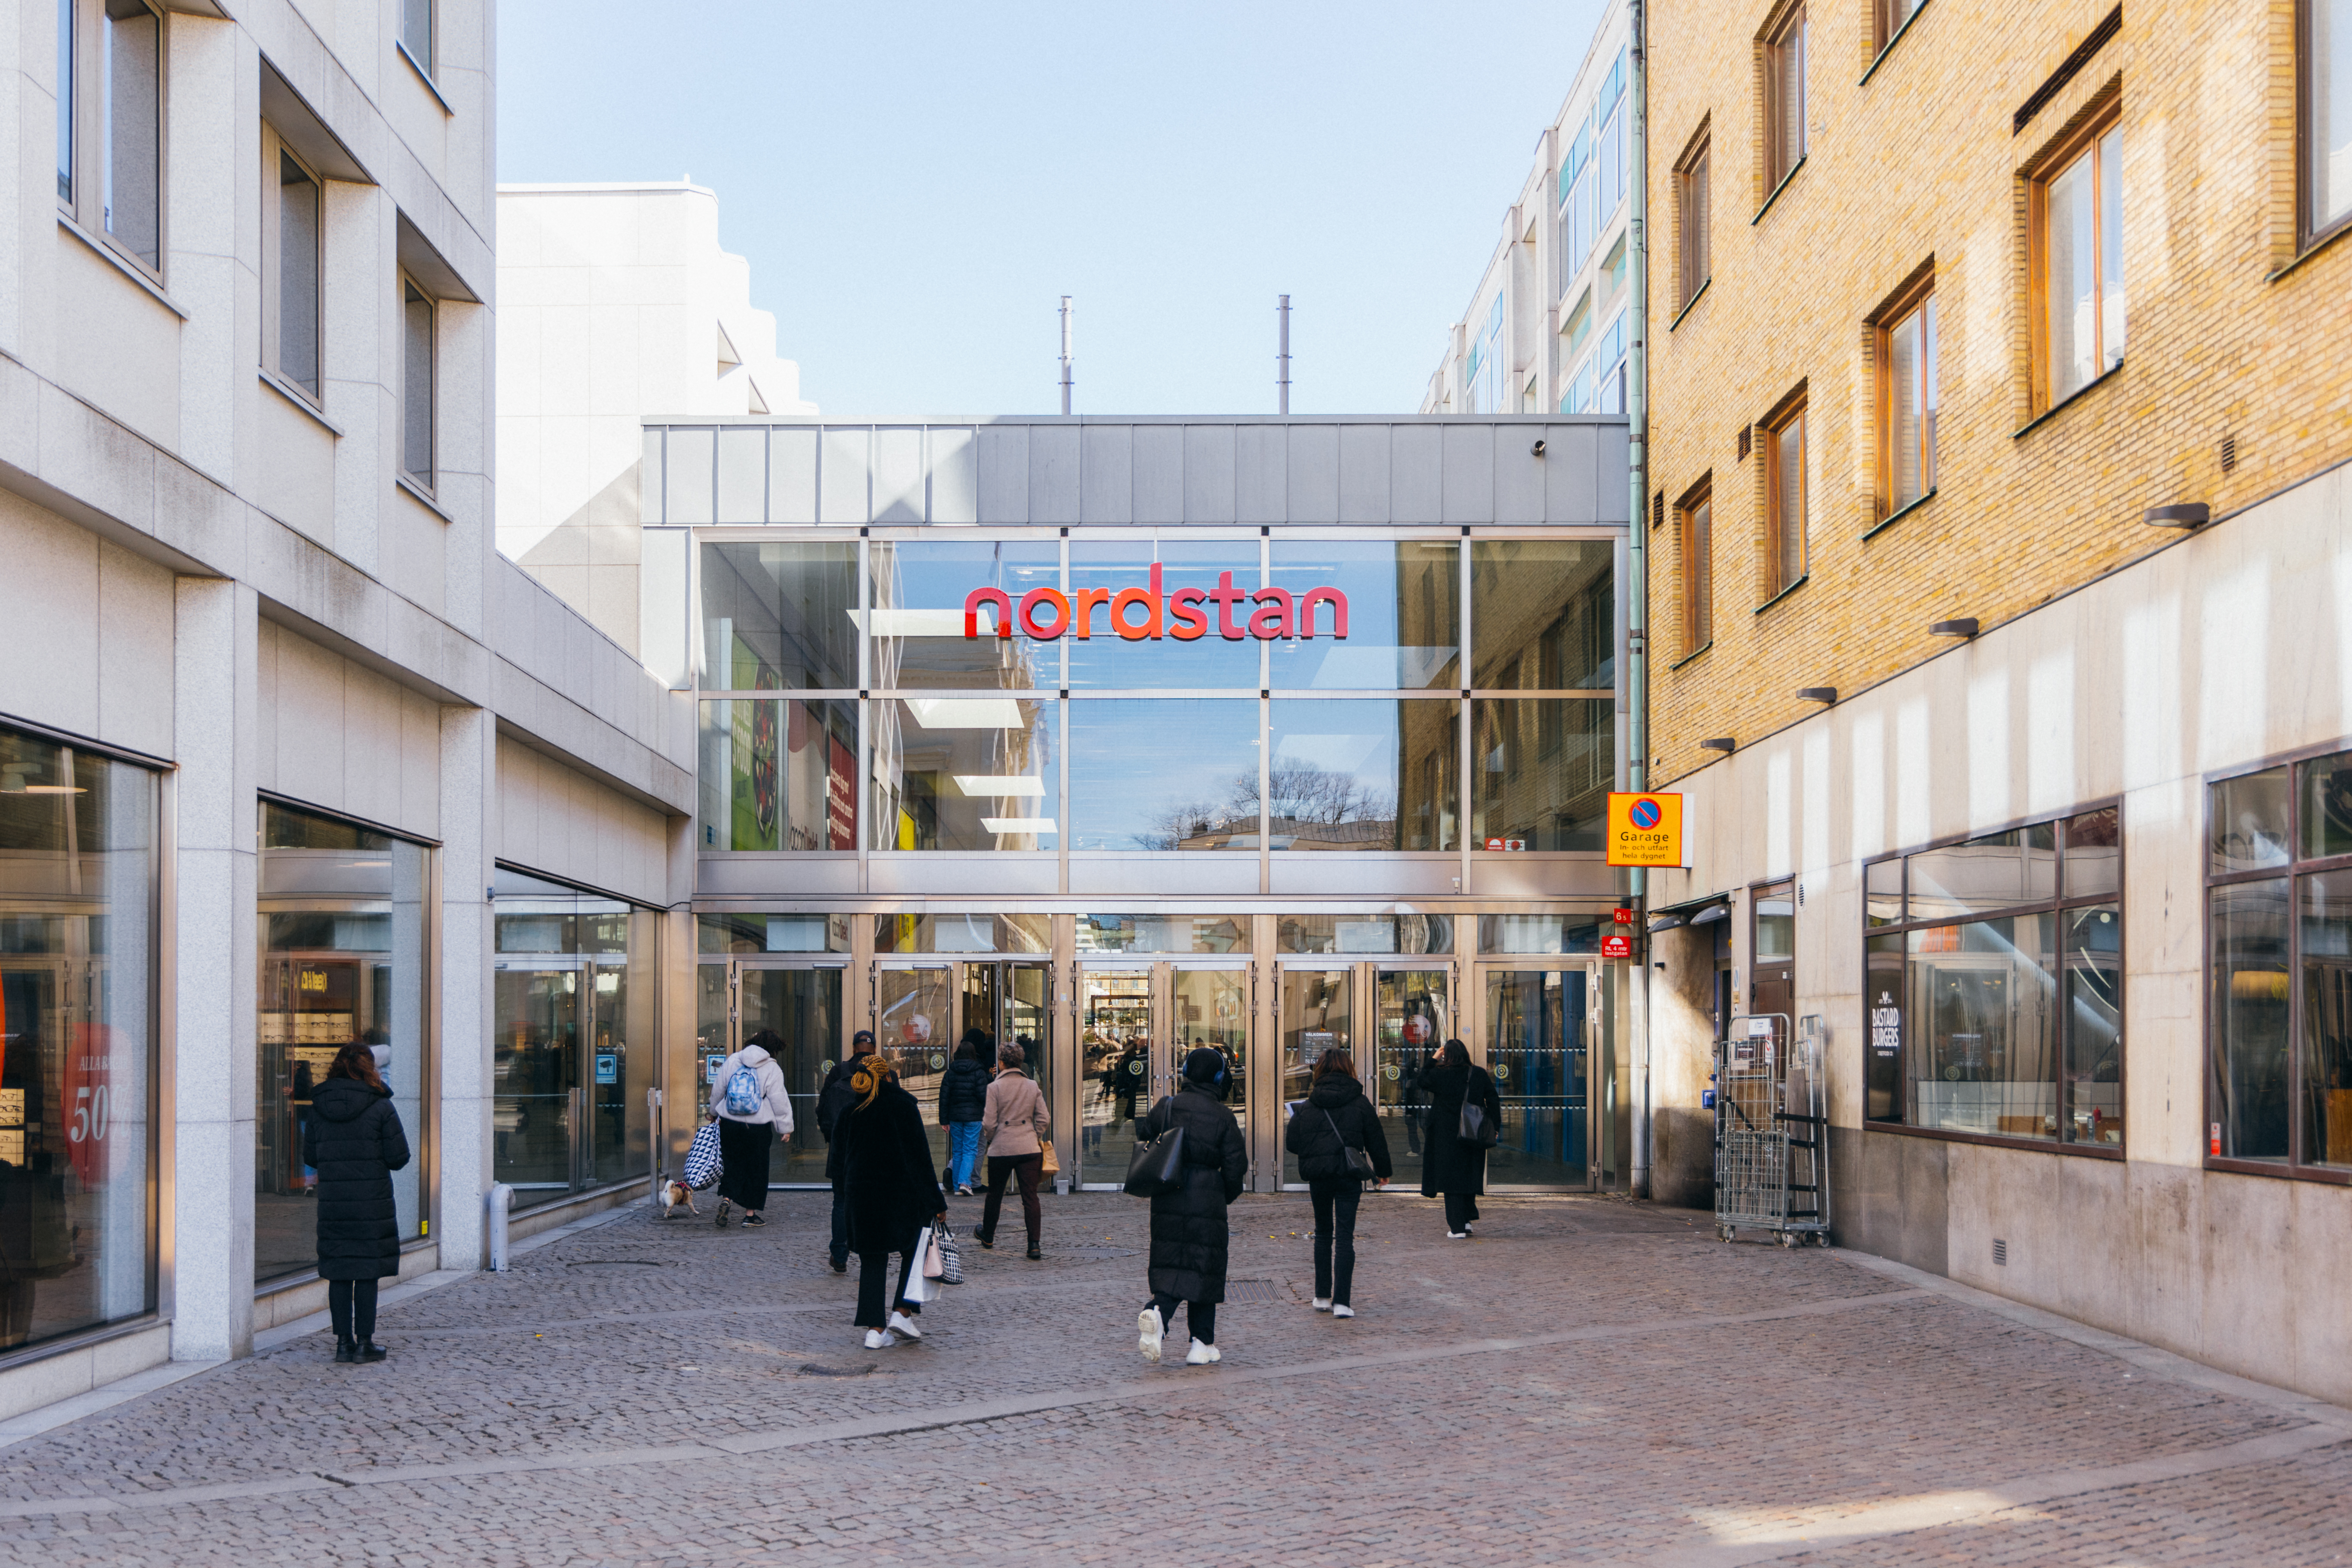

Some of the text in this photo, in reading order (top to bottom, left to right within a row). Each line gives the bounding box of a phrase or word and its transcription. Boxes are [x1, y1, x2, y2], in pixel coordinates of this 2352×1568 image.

[965, 562, 1349, 640] nordstan
[1620, 831, 1669, 844] Garage
[1872, 1008, 1899, 1027] BASTARD
[1872, 1027, 1899, 1047] BURGERS
[79, 1056, 100, 1071] ALLA
[71, 1084, 131, 1142] 50%
